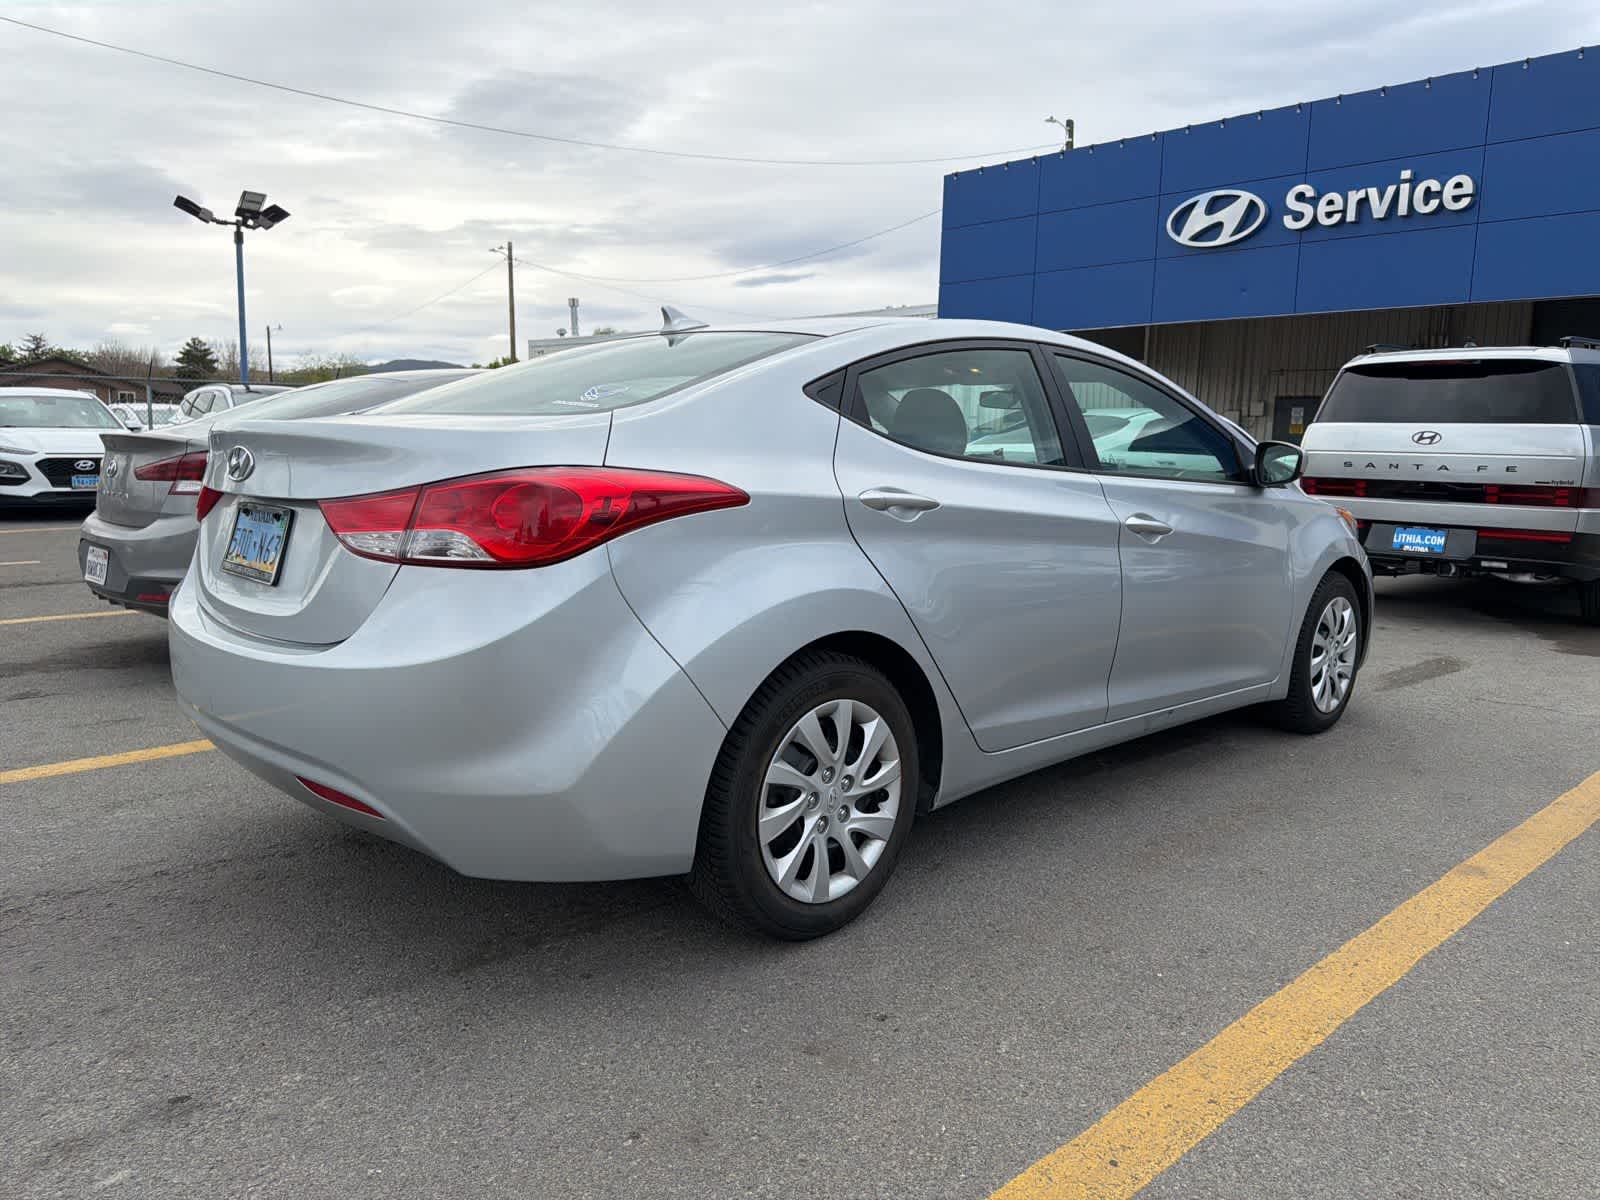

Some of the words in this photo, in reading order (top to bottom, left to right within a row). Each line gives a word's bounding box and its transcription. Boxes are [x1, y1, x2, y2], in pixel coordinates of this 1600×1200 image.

[1283, 169, 1474, 230] Service
[1343, 461, 1450, 472] SANTA
[1476, 465, 1518, 473] FE
[1393, 532, 1446, 546] LITHIA.COM
